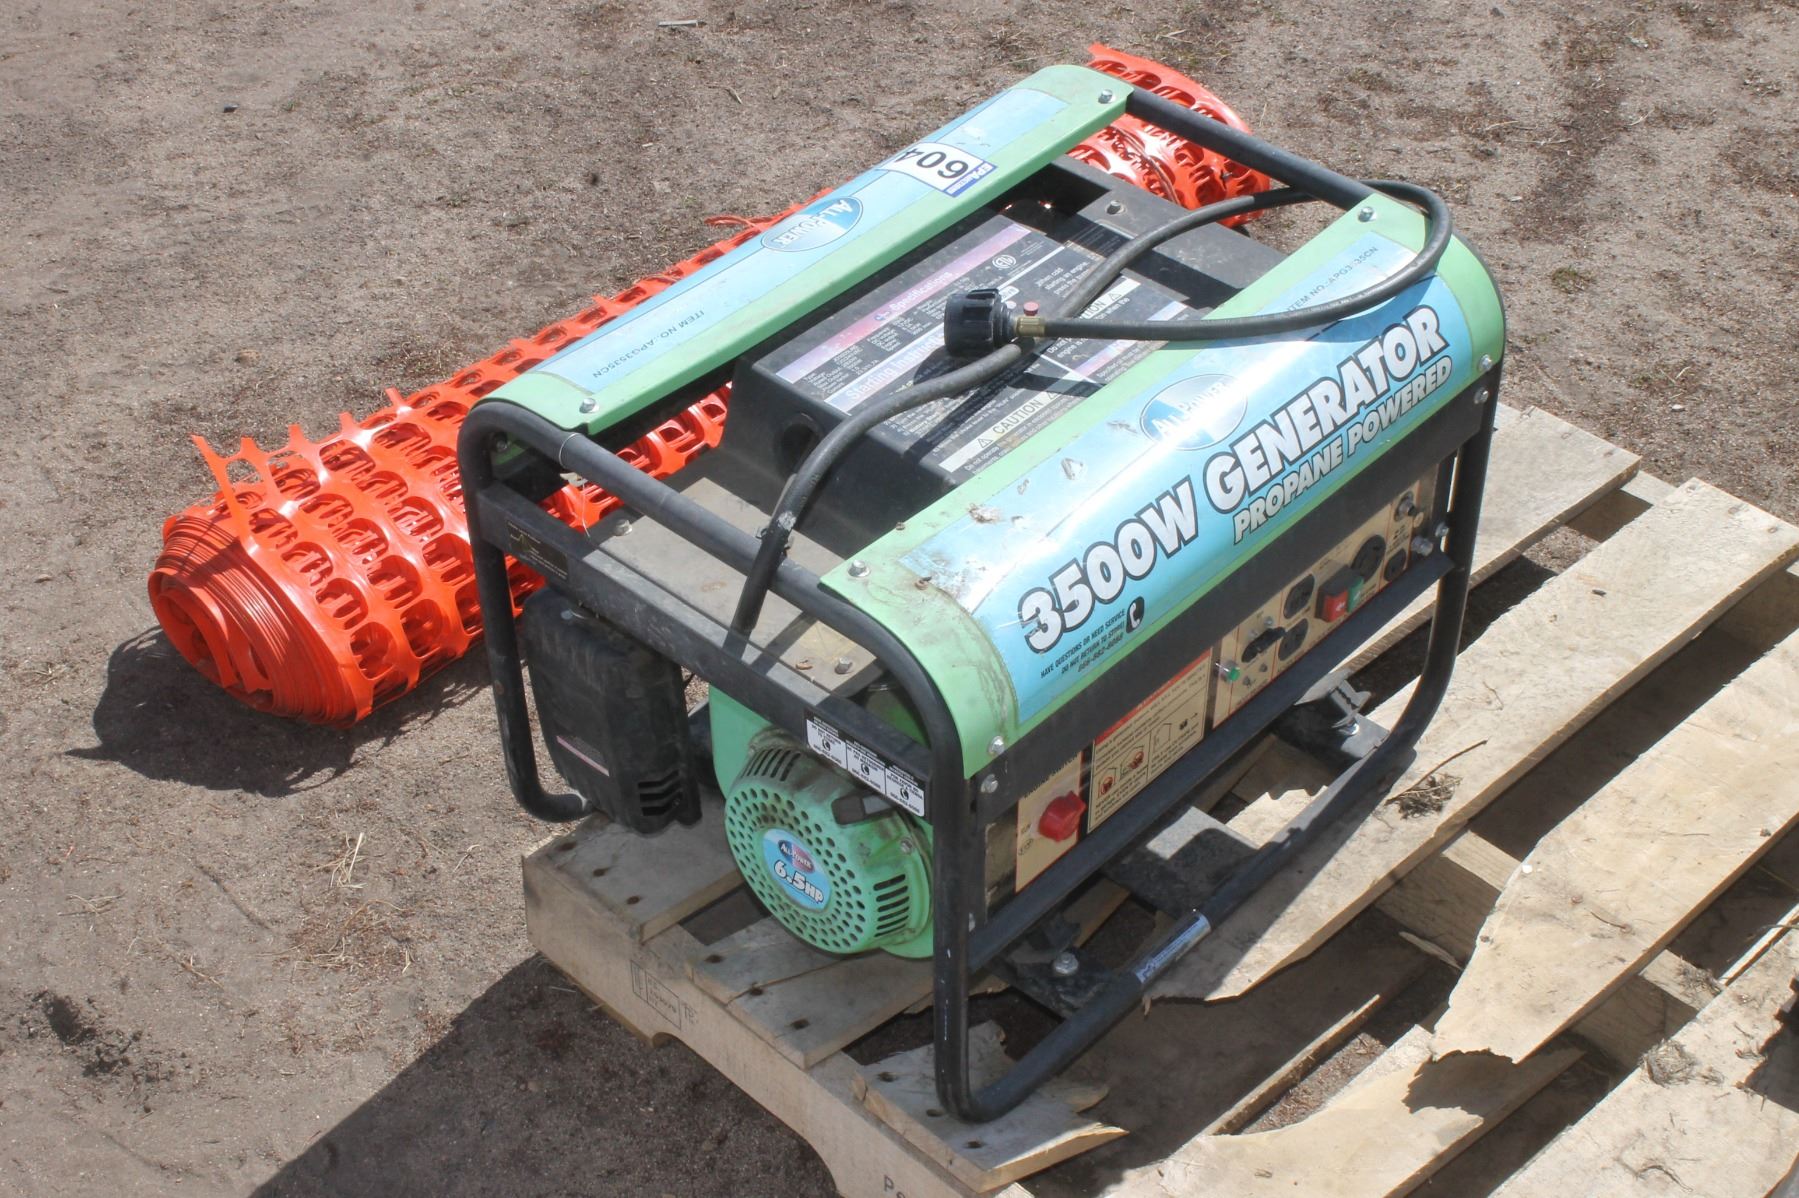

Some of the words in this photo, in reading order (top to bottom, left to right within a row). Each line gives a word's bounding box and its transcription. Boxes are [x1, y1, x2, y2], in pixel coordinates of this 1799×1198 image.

[894, 148, 969, 179] 604
[1043, 276, 1067, 291] starting
[1048, 266, 1065, 276] cold
[889, 271, 953, 312] Specifications
[678, 309, 705, 328] ITEM
[1045, 345, 1059, 354] Do
[1053, 338, 1068, 348] not
[1054, 343, 1079, 359] engine
[845, 364, 895, 400] Starting
[992, 399, 1044, 436] CAUTION
[1203, 304, 1449, 514] GENERATOR
[1233, 444, 1345, 546] PROPANE
[1347, 356, 1453, 458] POWERED
[1018, 475, 1200, 655] 3500W
[1040, 663, 1054, 678] HAVE
[1055, 642, 1082, 667] QUESTIONS
[1083, 636, 1091, 646] OR
[1091, 625, 1104, 640] NEED
[1105, 609, 1125, 629] SERVICE
[1061, 666, 1068, 674] DO
[1069, 658, 1080, 671] NOT
[1080, 643, 1100, 661] RETURN
[1101, 637, 1107, 646] TO
[780, 843, 812, 869] ALL-POWER
[774, 859, 824, 903] 6.5HP
